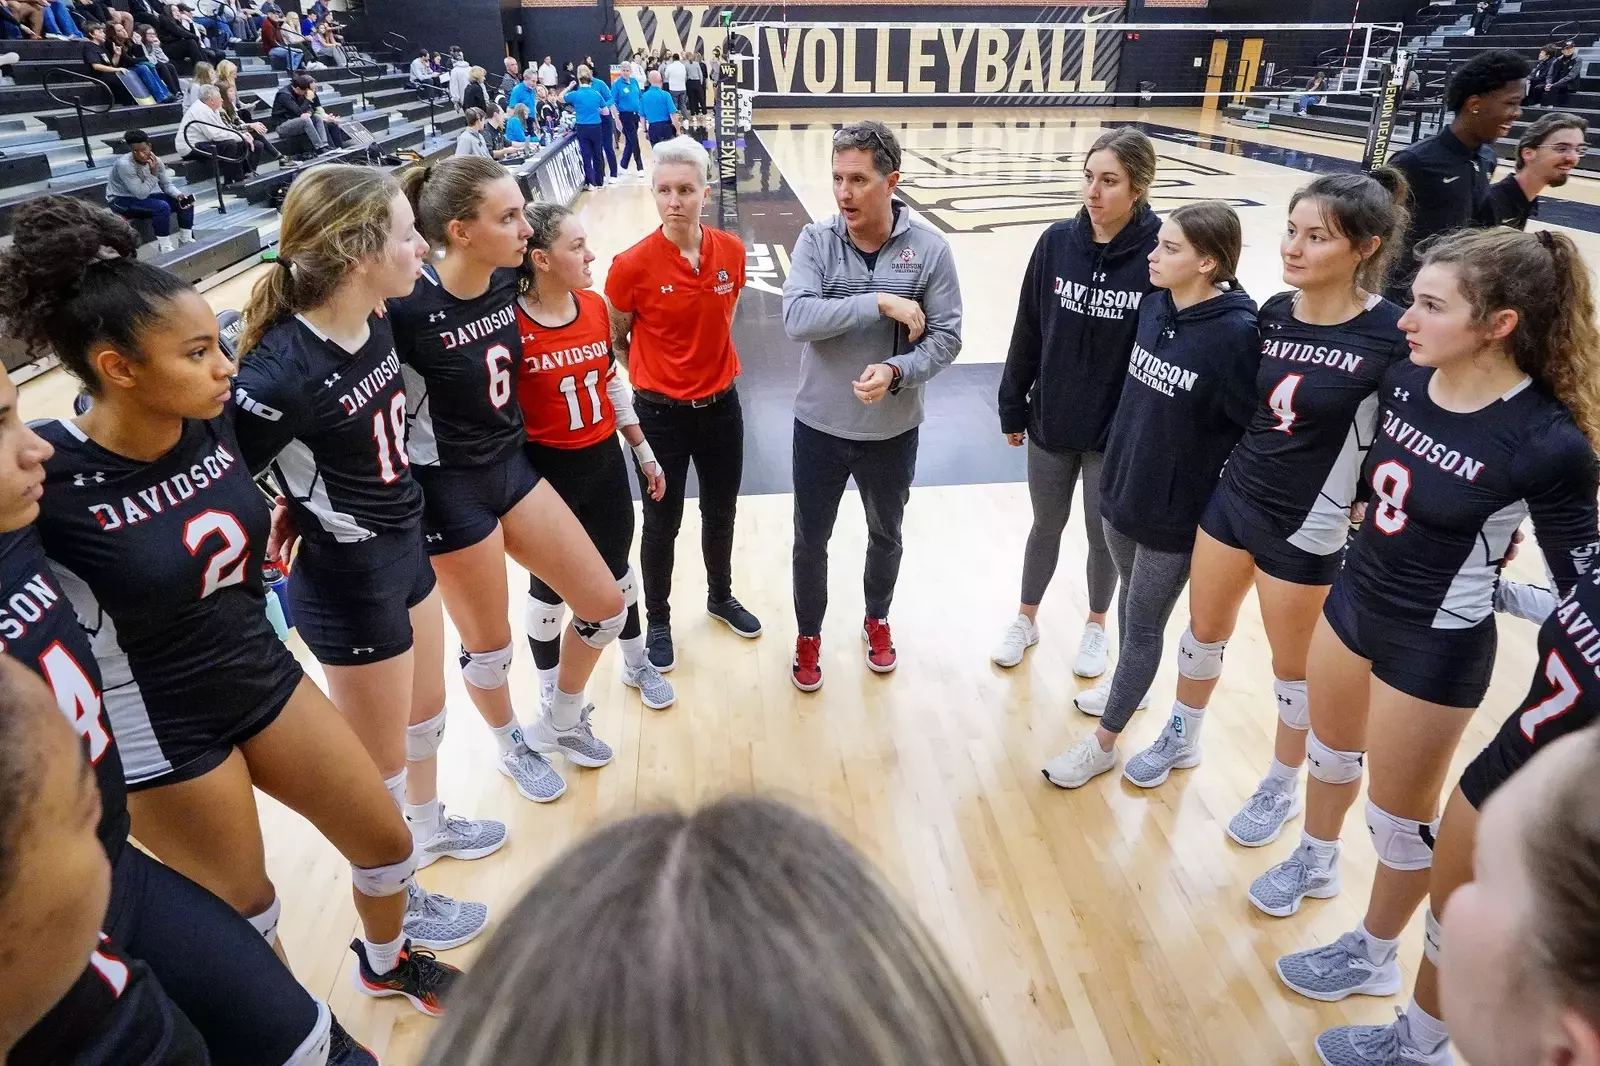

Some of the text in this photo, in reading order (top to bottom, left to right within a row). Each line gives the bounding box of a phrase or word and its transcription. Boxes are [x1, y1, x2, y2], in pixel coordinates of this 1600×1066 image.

[720, 65, 736, 78] WF
[765, 27, 1107, 95] VOLLEYBALL
[720, 82, 736, 178] WAKE FOREST
[1371, 120, 1390, 170] DEACONS
[439, 304, 517, 350] DAVIDSON
[524, 340, 608, 374] DAVIDSON
[1261, 339, 1364, 373] DAVIDSON
[338, 347, 401, 417] DAVIDSON
[486, 342, 513, 412] 6
[558, 369, 604, 432] 11
[1267, 372, 1304, 436] 4
[1382, 409, 1486, 482] DAVIDSON
[88, 443, 236, 531] DAVIDSON
[1372, 459, 1412, 536] 8
[182, 508, 250, 600] 2
[1519, 648, 1584, 744] 7
